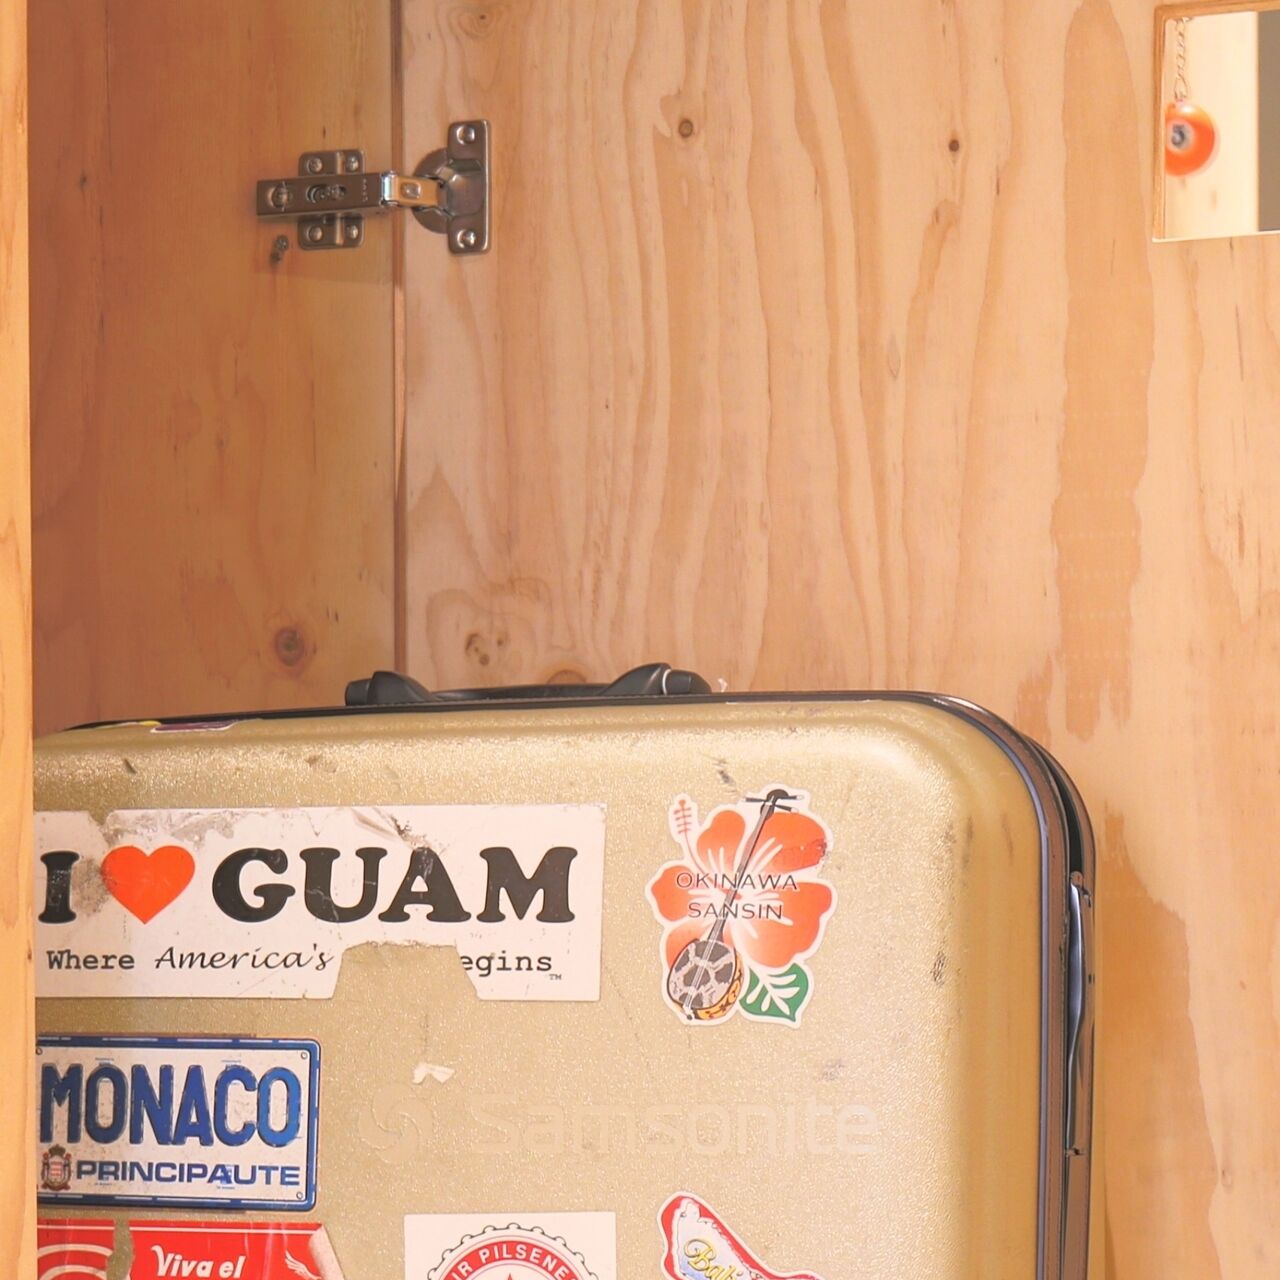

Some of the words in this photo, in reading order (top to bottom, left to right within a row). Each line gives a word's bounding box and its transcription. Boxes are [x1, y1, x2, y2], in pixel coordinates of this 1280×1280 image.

[38, 850, 80, 924] I
[211, 845, 578, 924] GUAM
[676, 872, 798, 891] OKINAWA
[688, 902, 783, 920] SANSIN
[46, 949, 135, 970] Where
[154, 943, 334, 971] America's
[460, 953, 554, 978] egins
[39, 1063, 302, 1147] MONACO
[472, 1100, 881, 1155] Samsonite
[76, 1160, 301, 1187] PRINCIPAUTE
[151, 1245, 212, 1278] Viva
[219, 1256, 247, 1279] el
